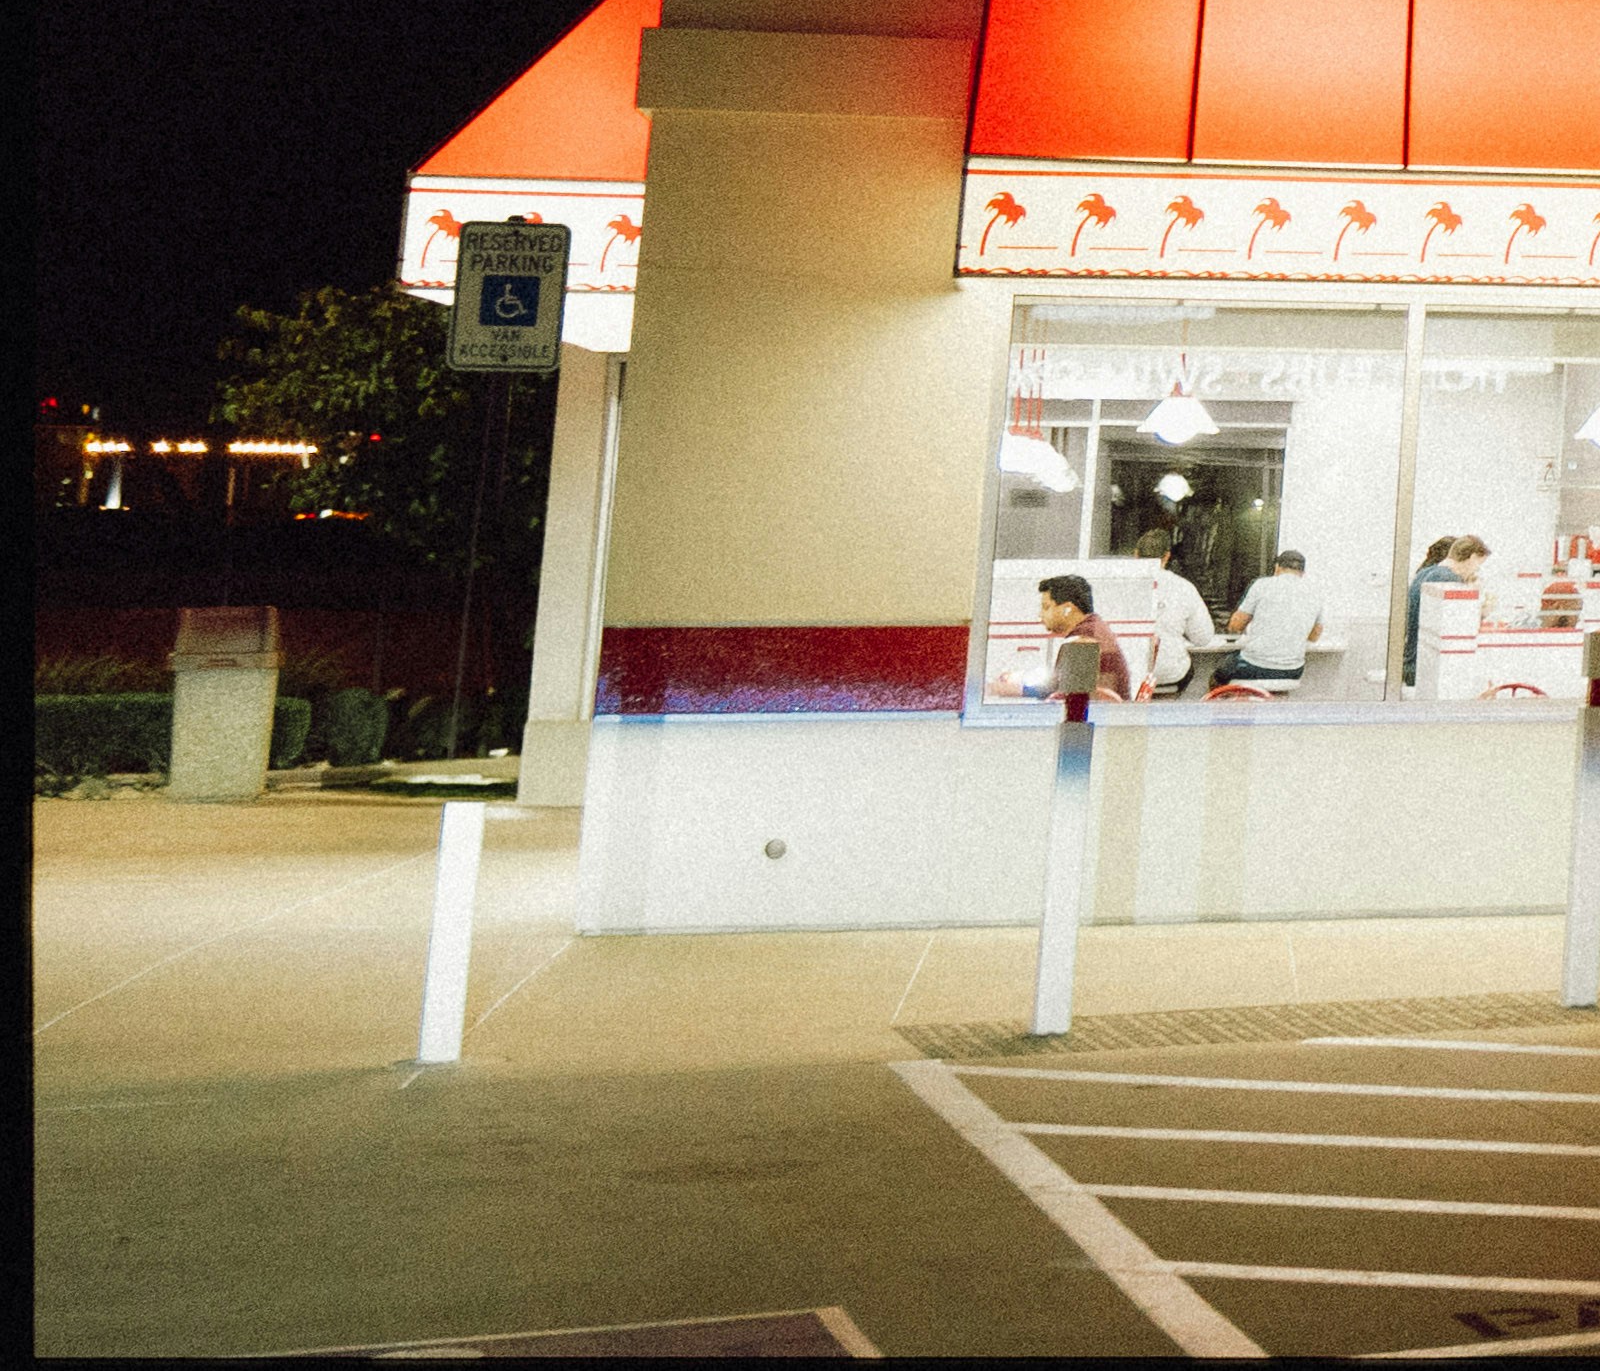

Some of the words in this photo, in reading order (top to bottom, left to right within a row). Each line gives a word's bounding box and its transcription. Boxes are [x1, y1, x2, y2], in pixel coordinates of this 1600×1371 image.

[465, 231, 563, 252] RESERVED
[470, 253, 555, 273] PARKING
[492, 329, 521, 342] VAN
[459, 342, 550, 359] ACCESSIBLE
